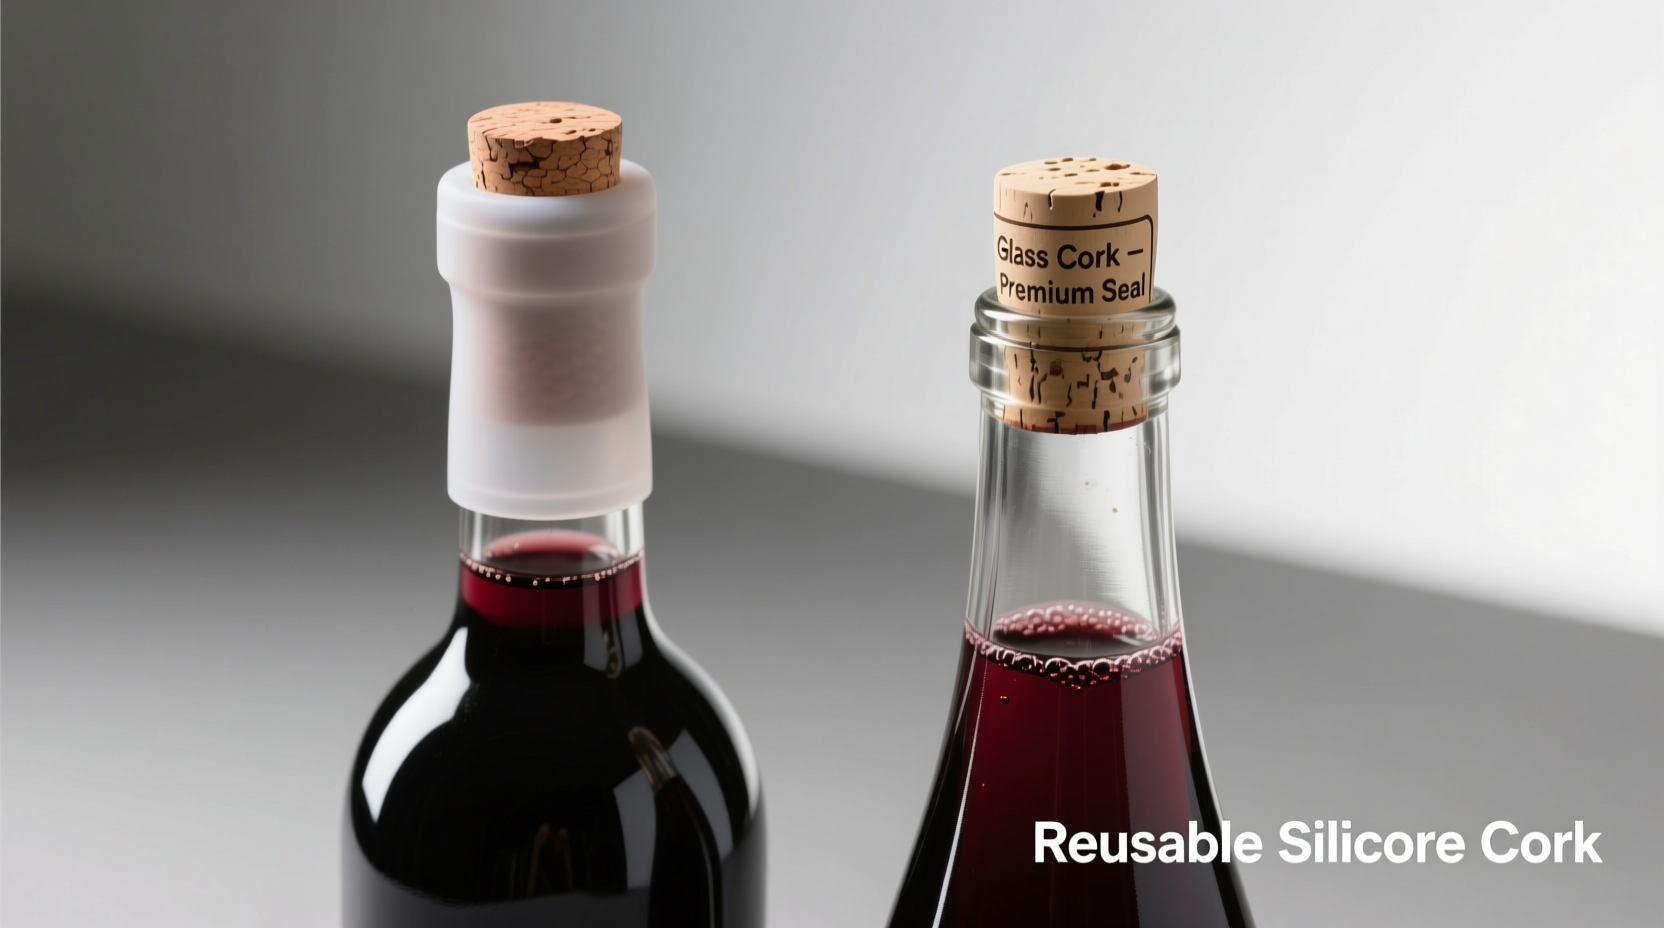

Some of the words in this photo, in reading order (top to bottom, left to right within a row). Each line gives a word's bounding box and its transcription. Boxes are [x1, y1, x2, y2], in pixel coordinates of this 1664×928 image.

[997, 235, 1049, 269] Glass
[1056, 242, 1120, 270] Cork
[999, 272, 1094, 305] Premium
[1101, 272, 1146, 302] Seal
